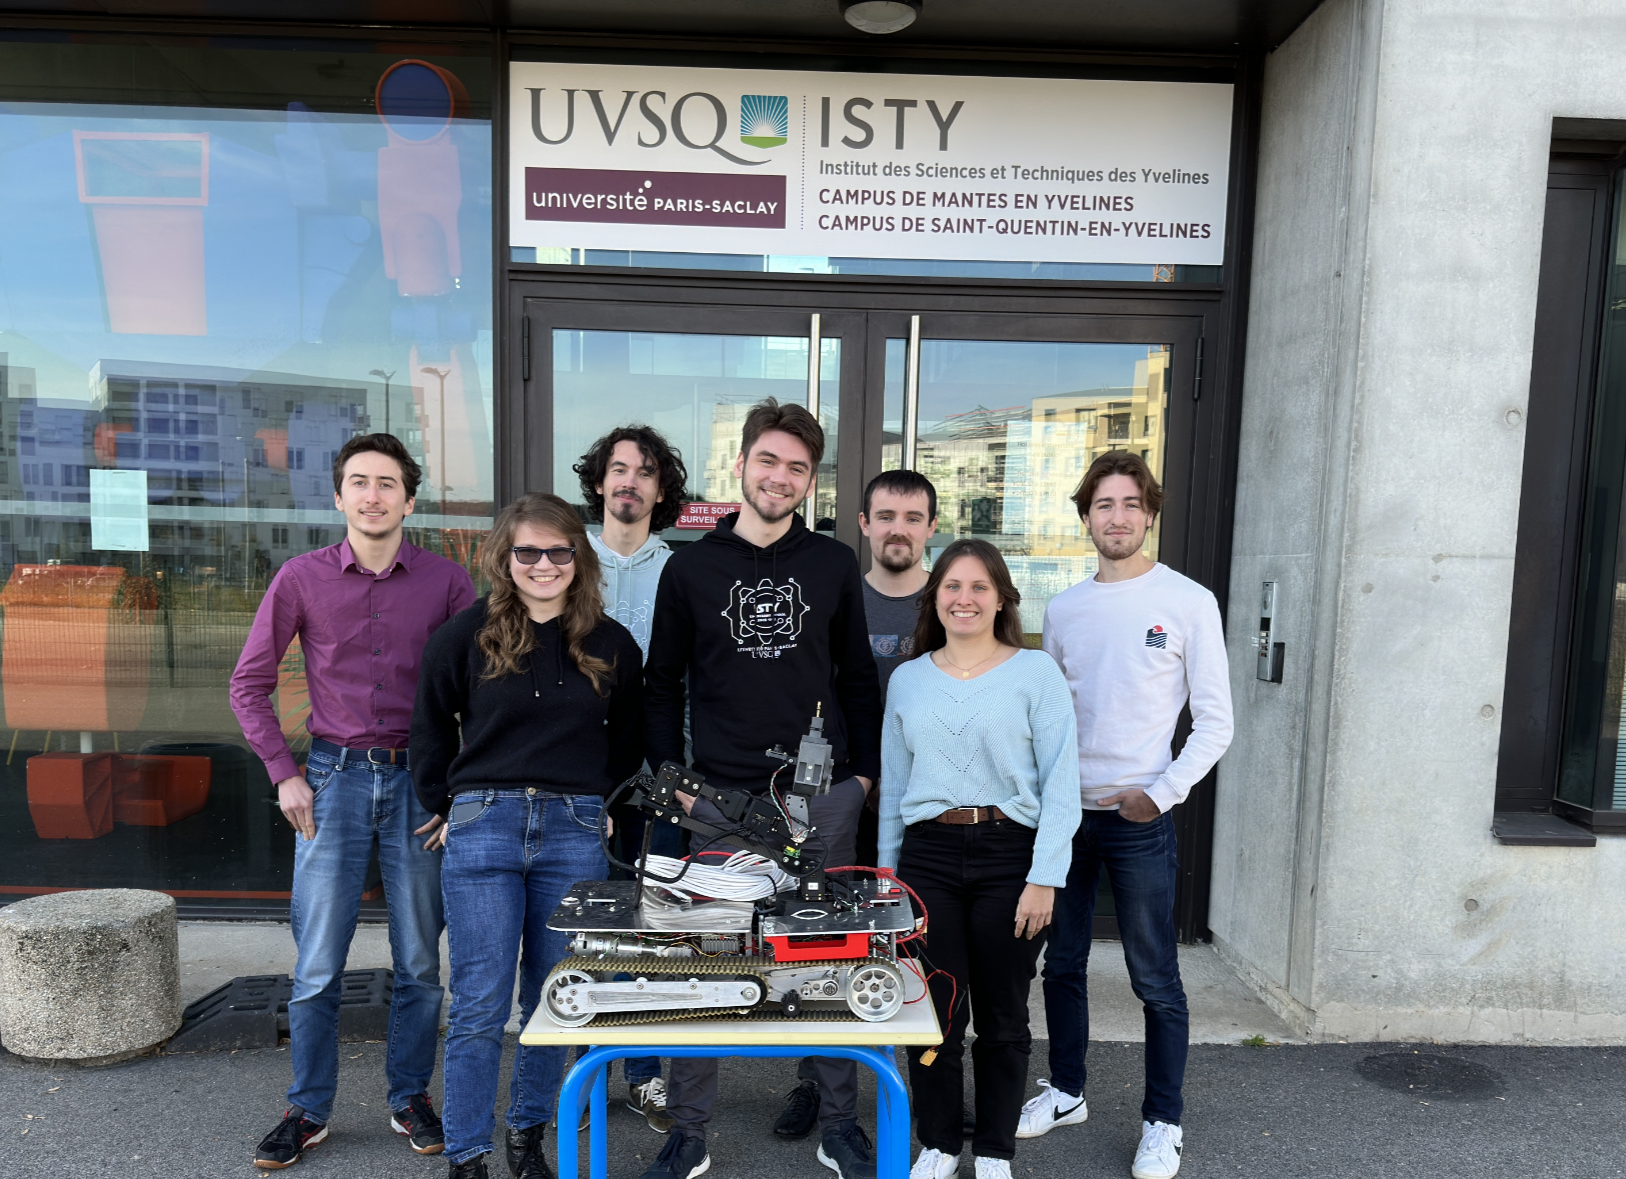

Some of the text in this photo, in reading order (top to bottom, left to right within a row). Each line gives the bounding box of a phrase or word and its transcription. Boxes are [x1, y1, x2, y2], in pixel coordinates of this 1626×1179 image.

[524, 87, 772, 166] UVSQ
[820, 96, 966, 152] ISTY
[819, 159, 1210, 185] Institut des Sciences et Techniques des Yvelines
[533, 180, 778, 215] université PARIS-SACLAY
[818, 188, 1135, 212] CAMPUS DE MANTES EN YVELINES
[817, 214, 1212, 240] CAMPUS DE SAINT-QUENTIN-EN-YVELINES
[681, 515, 719, 524] SURVEIL
[690, 506, 735, 515] SITE SOUS
